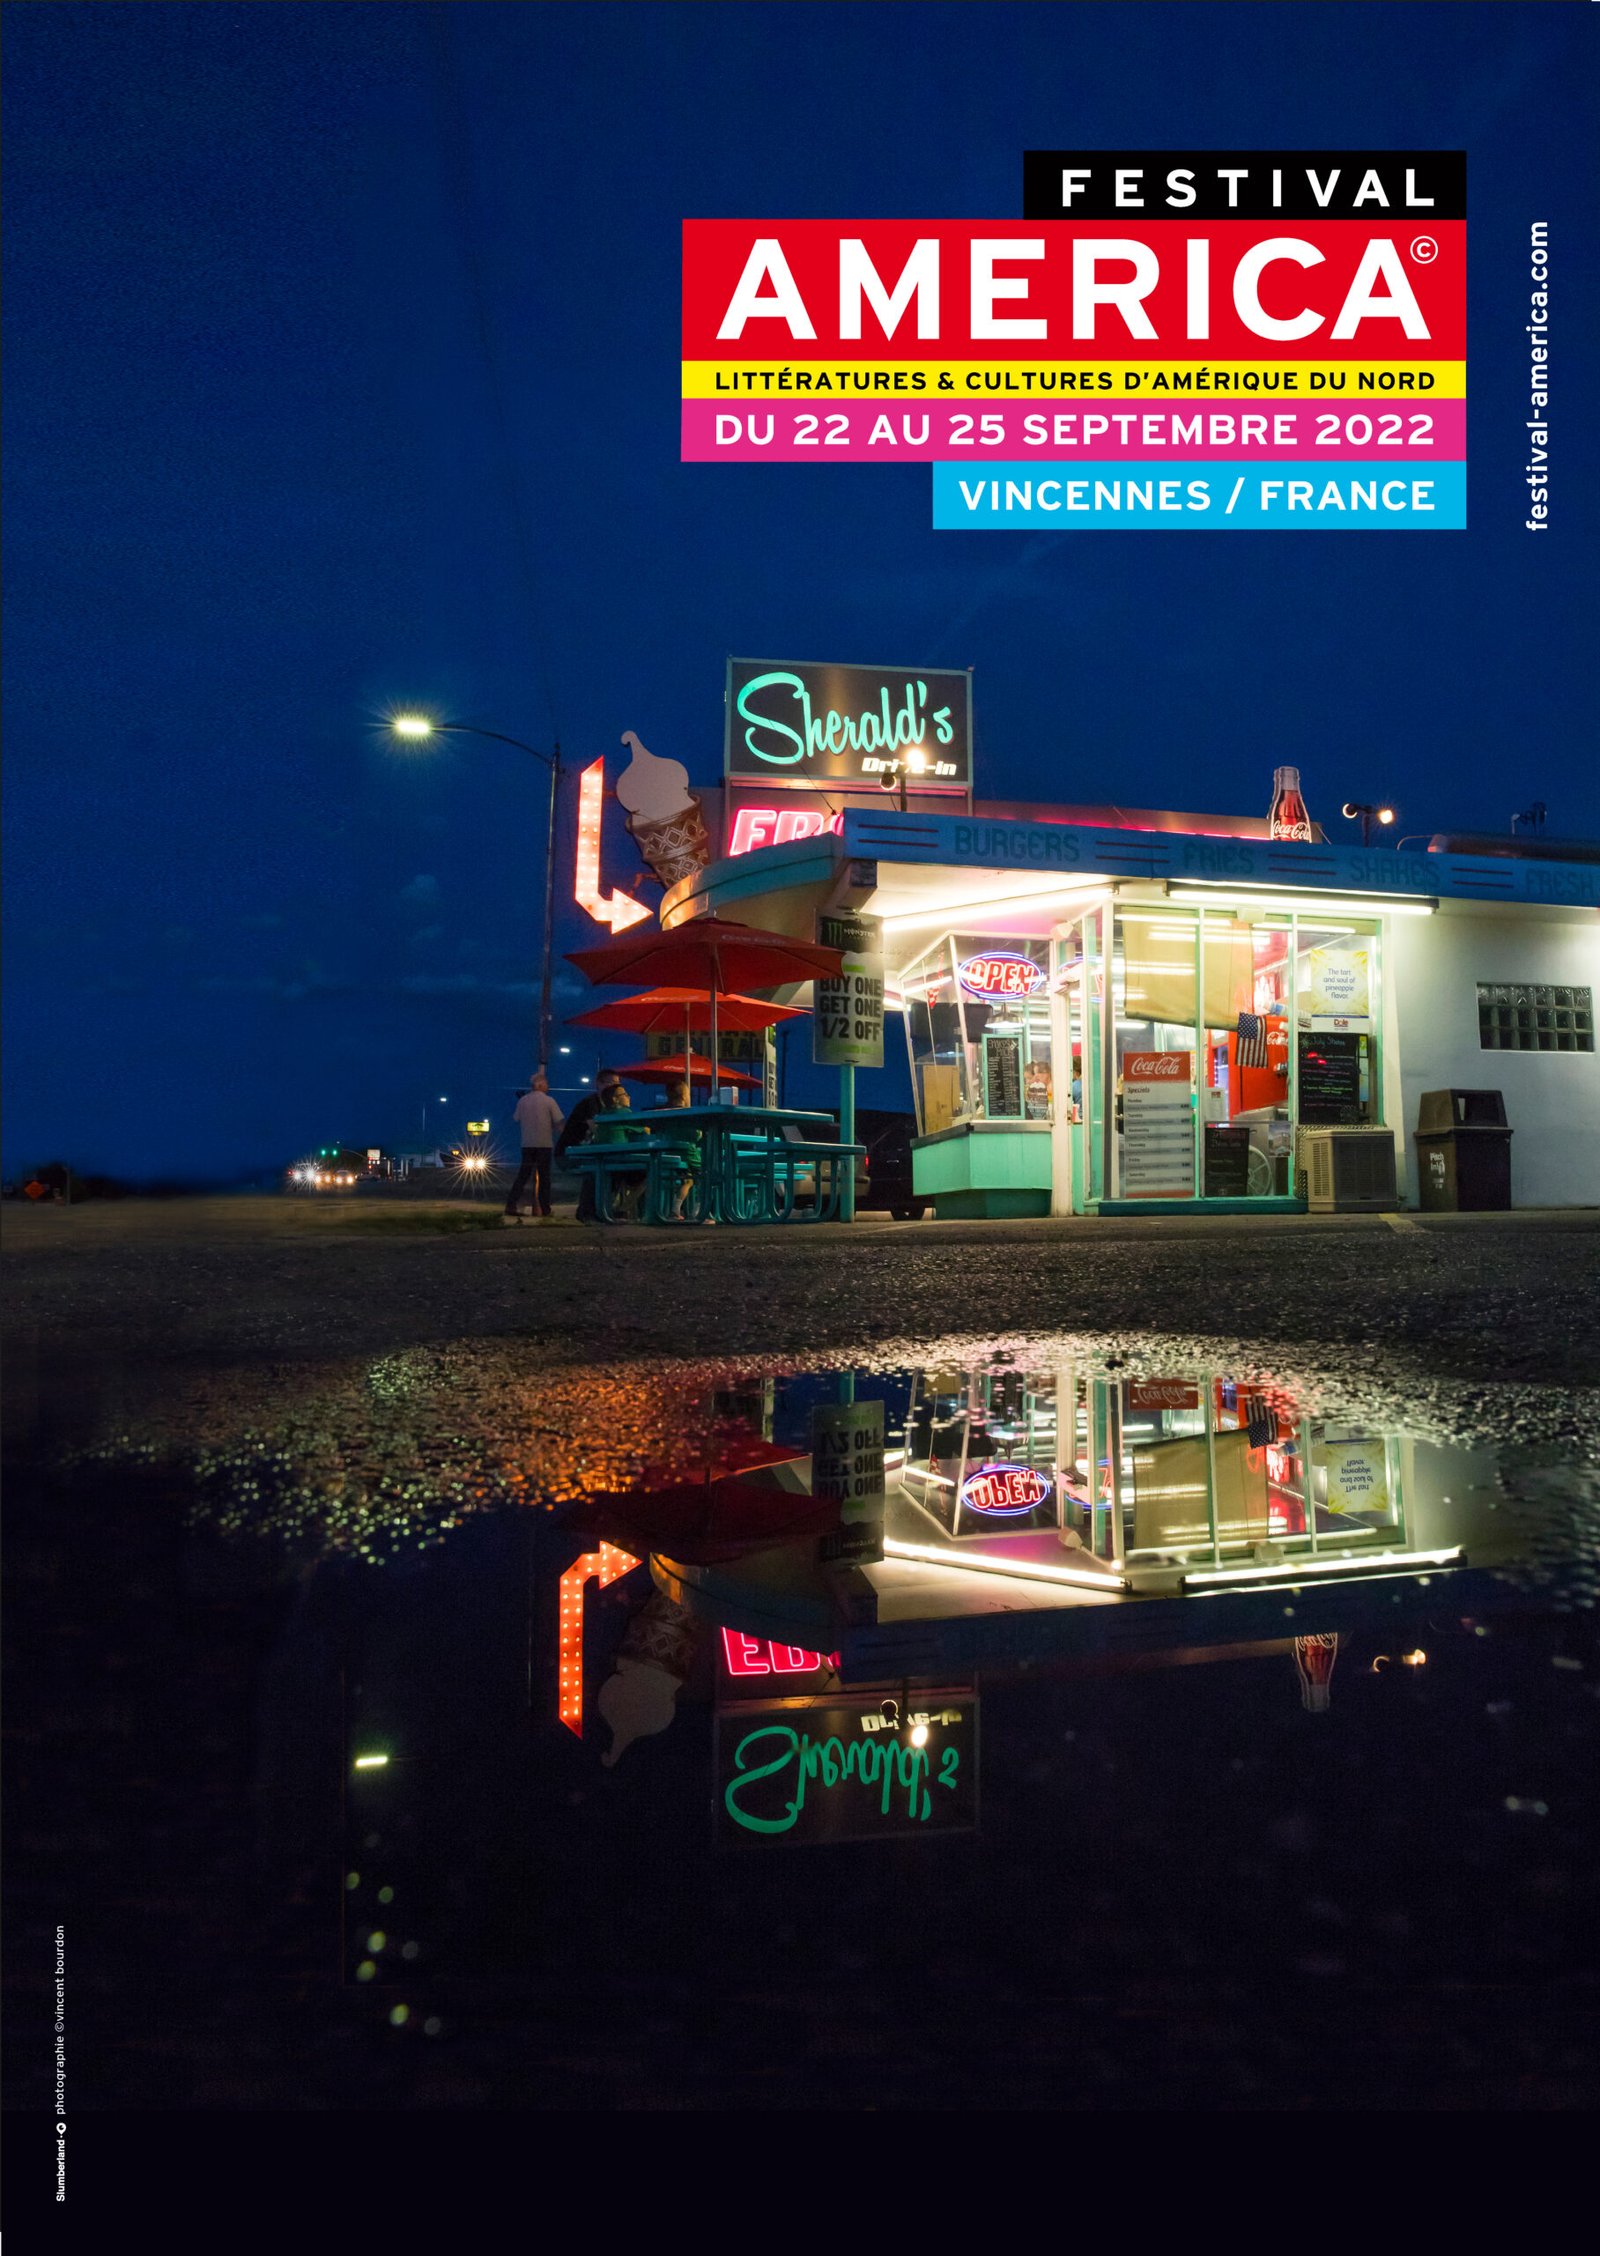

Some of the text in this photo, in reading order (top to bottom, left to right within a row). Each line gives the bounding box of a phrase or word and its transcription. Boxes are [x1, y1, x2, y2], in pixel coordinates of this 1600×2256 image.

[738, 672, 953, 764] Sherald's
[954, 824, 1080, 863] BURGERS
[1183, 841, 1254, 875] FRIES
[1350, 858, 1440, 888] SHAKES
[969, 960, 1034, 993] OPEN
[1328, 968, 1339, 976] The
[820, 977, 882, 996] BUY ONE
[820, 996, 882, 1017] GET ONE
[820, 1018, 882, 1042] 1/2 OFF
[1131, 1056, 1182, 1076] Coca-Cola
